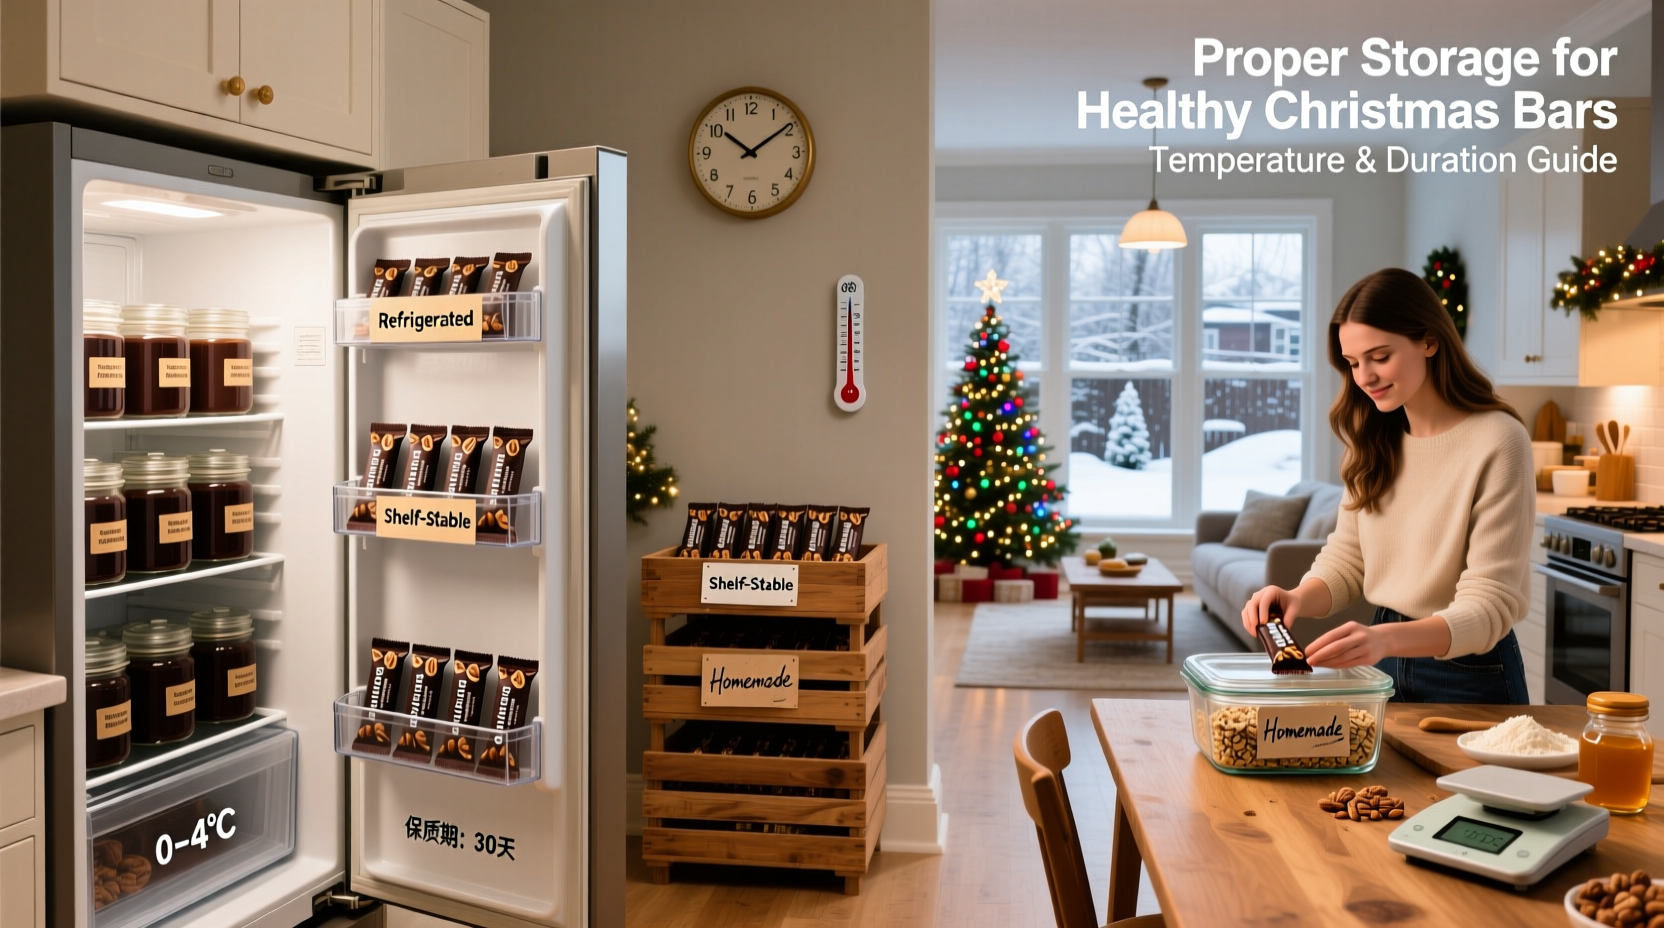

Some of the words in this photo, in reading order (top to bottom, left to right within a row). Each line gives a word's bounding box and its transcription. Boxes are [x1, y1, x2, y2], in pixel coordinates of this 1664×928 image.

[726, 108, 735, 121] 11
[745, 101, 758, 115] 12
[709, 123, 723, 138] 10
[784, 122, 794, 136] 2
[702, 146, 711, 160] 9
[792, 145, 801, 159] 3
[710, 168, 719, 182] 8
[784, 167, 793, 181] 4
[725, 184, 734, 198] 7
[771, 183, 780, 196] 5
[748, 190, 757, 204] 6
[379, 309, 474, 332] Refrigerated
[384, 508, 471, 529] Shelf-Stable
[709, 576, 794, 591] Shelf-Stable
[710, 664, 793, 695] Homemade
[1263, 715, 1343, 743] Homemade
